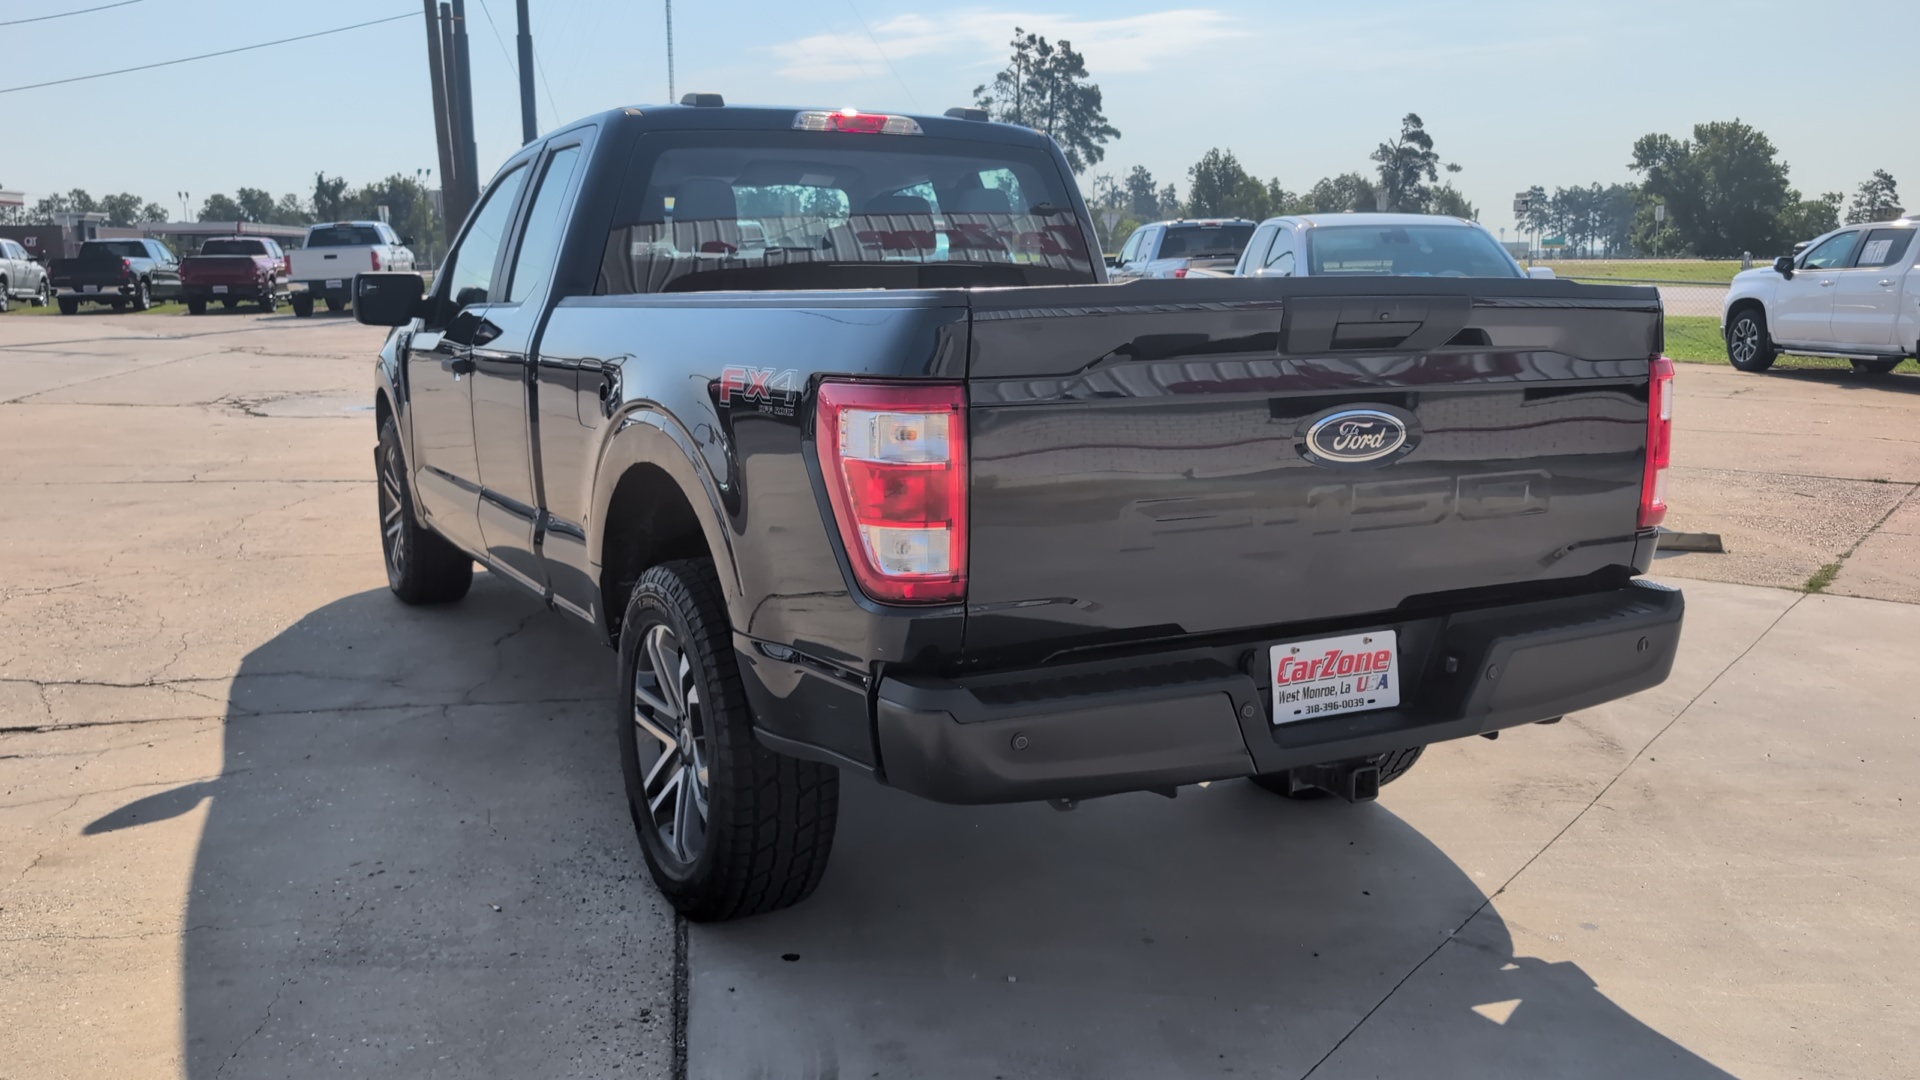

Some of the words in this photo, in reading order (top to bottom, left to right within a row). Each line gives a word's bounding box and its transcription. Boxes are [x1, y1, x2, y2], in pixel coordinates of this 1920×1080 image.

[719, 364, 798, 408] FX4
[1333, 421, 1387, 451] Ford
[1277, 649, 1392, 687] CarZone
[1279, 690, 1300, 705] West
[1301, 685, 1338, 701] Monroe,
[1340, 681, 1351, 695] La
[1356, 674, 1389, 692] USA
[1305, 697, 1365, 715] 318-396-0039
